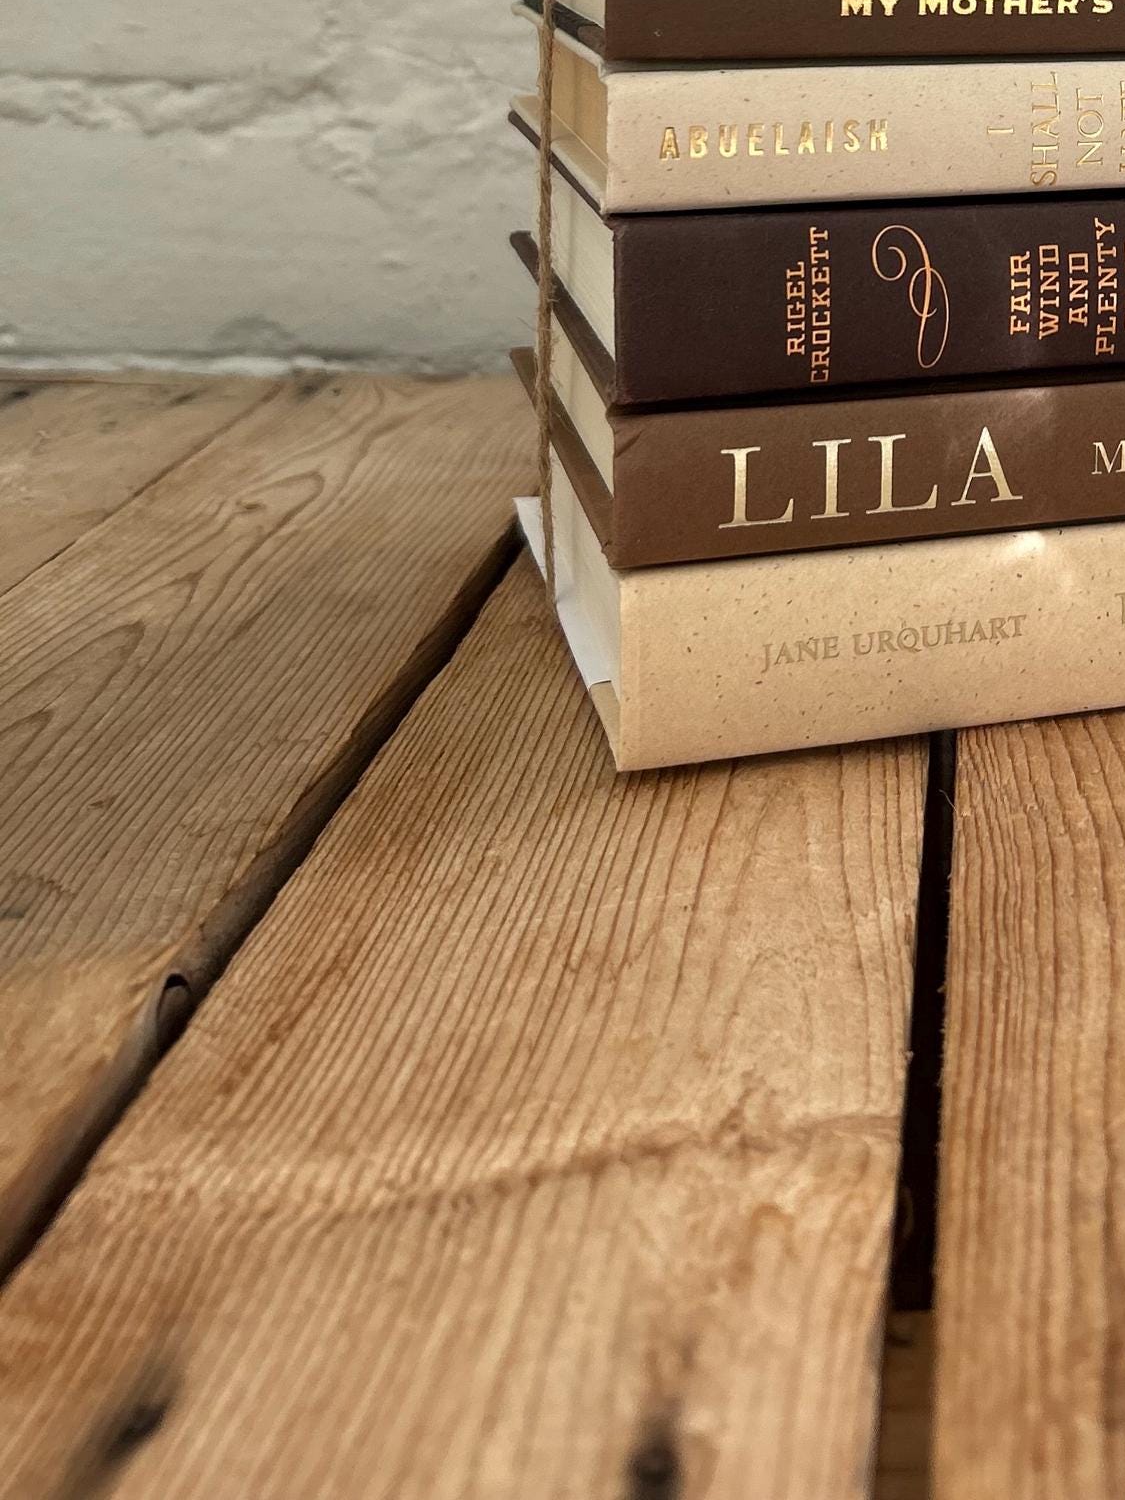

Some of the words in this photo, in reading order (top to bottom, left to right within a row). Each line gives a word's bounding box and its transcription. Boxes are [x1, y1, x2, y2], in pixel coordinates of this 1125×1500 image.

[658, 118, 888, 161] ABUELAISH
[1030, 71, 1061, 186] SHALL
[1076, 87, 1104, 167] NOT
[786, 261, 806, 356] RIGEL
[809, 227, 831, 383] CROCKETT
[1010, 251, 1031, 335] FAIR
[1038, 244, 1060, 340] WIND
[1068, 252, 1088, 327] AND
[1094, 217, 1116, 356] PLENTY
[718, 425, 1023, 529] LILA
[761, 635, 840, 674] JANE
[853, 614, 1027, 656] URQUHART
